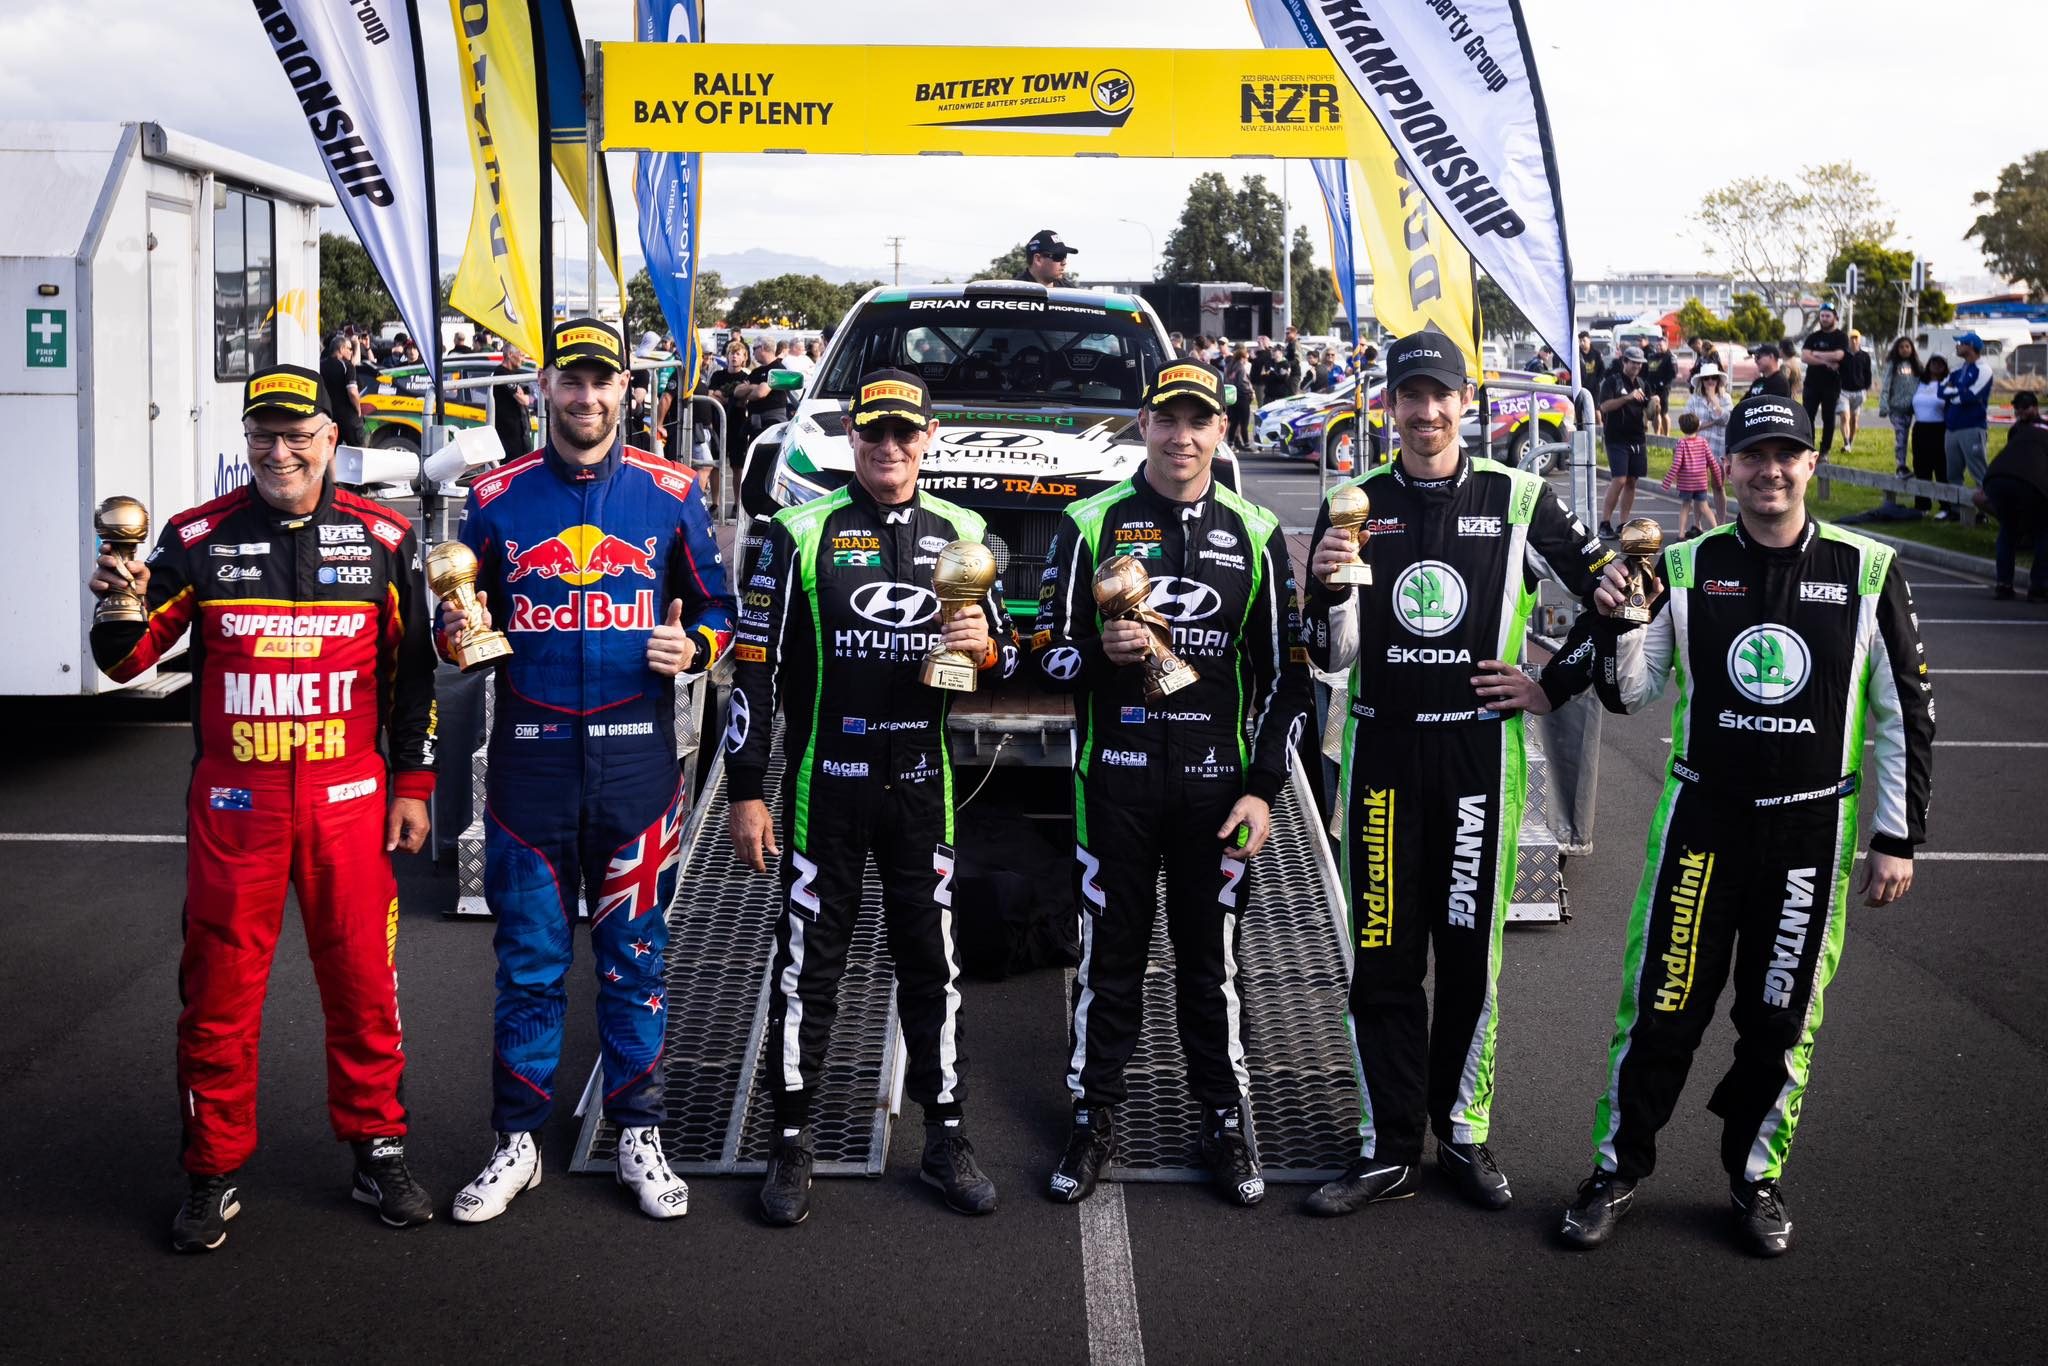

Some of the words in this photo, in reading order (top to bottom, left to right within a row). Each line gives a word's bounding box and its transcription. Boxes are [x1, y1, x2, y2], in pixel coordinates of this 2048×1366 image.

[1463, 35, 1509, 93] Group
[693, 73, 774, 97] RALLY
[915, 75, 1016, 102] BATTERY
[1021, 70, 1089, 94] TOWN
[938, 101, 984, 112] NATIONWIDE
[986, 98, 1017, 109] BATTERY
[1020, 95, 1066, 107] SPECIALISTS
[1240, 83, 1341, 123] NZR
[634, 101, 689, 124] BAY
[694, 101, 733, 125] OF
[739, 102, 834, 126] PLENTY
[1320, 0, 1526, 239] HAMPIONSHIP
[909, 299, 970, 310] BRIAN
[976, 300, 1045, 312] GREEN
[1048, 305, 1107, 316] PROPERTIES
[1131, 311, 1142, 324] 1
[36, 348, 57, 356] FIRST
[254, 378, 311, 393] PIRELLI
[1161, 368, 1214, 387] PIRELLI
[864, 383, 918, 400] PIRELLI
[1499, 397, 1550, 416] RACIG
[1744, 402, 1794, 417] ŠKODA
[932, 411, 1074, 426] artercard
[1744, 414, 1795, 428] Motorsport
[922, 449, 1059, 465] HYUNDAI
[972, 458, 1059, 471] ZEALAND
[214, 453, 254, 498] Moto
[661, 476, 687, 490] OMP
[480, 481, 503, 497] OMP
[914, 476, 967, 490] MITRE
[972, 477, 998, 490] 10
[1002, 478, 1077, 497] TRADE
[1122, 521, 1144, 529] MITRE
[1378, 517, 1398, 525] Neil
[1458, 519, 1501, 533] NZRC
[181, 521, 209, 539] OMP
[319, 526, 365, 540] NZRC
[373, 521, 402, 541] OMP
[1115, 529, 1162, 541] TRADE
[832, 537, 880, 549] TRADE
[920, 540, 947, 548] BAILEY
[1210, 533, 1236, 544] BAILEY
[318, 546, 372, 556] WARD
[913, 555, 938, 565] Winm
[1670, 549, 1684, 580] sparco
[336, 567, 371, 575] QUAD
[1868, 551, 1886, 587] sparco
[337, 575, 373, 584] LOCK
[1800, 584, 1848, 601] NZRC
[508, 591, 581, 632] Red
[585, 589, 655, 632] Bull
[221, 612, 366, 638] SUPERCHEAP
[835, 629, 943, 651] HYUNDA
[1171, 626, 1229, 648] NDAI
[262, 641, 314, 653] AUTO
[835, 649, 868, 658] NEW
[879, 651, 929, 661] ZEAL
[1386, 645, 1472, 663] ŠKODA
[224, 671, 321, 716] MAKE
[328, 670, 358, 714] IT
[1147, 711, 1159, 719] H.
[1416, 713, 1442, 722] BEN
[1442, 711, 1475, 722] HUNT
[1719, 710, 1817, 733] ŠKODA
[515, 727, 540, 737] OMP
[588, 725, 606, 737] VAN
[608, 722, 654, 737] GISBERGEN
[231, 719, 346, 762] SUPER
[1102, 749, 1148, 762] RACER
[823, 759, 869, 771] RACER
[900, 771, 915, 780] BEN
[917, 768, 939, 777] NEVIS
[1755, 797, 1783, 807] TONY
[1783, 786, 1837, 804] RAWSTORN
[1361, 787, 1389, 948] Hydraulink
[1448, 794, 1487, 929] VANTAGE
[1654, 850, 1710, 1011] Hydraulink
[1763, 866, 1817, 1008] VANTAGE
